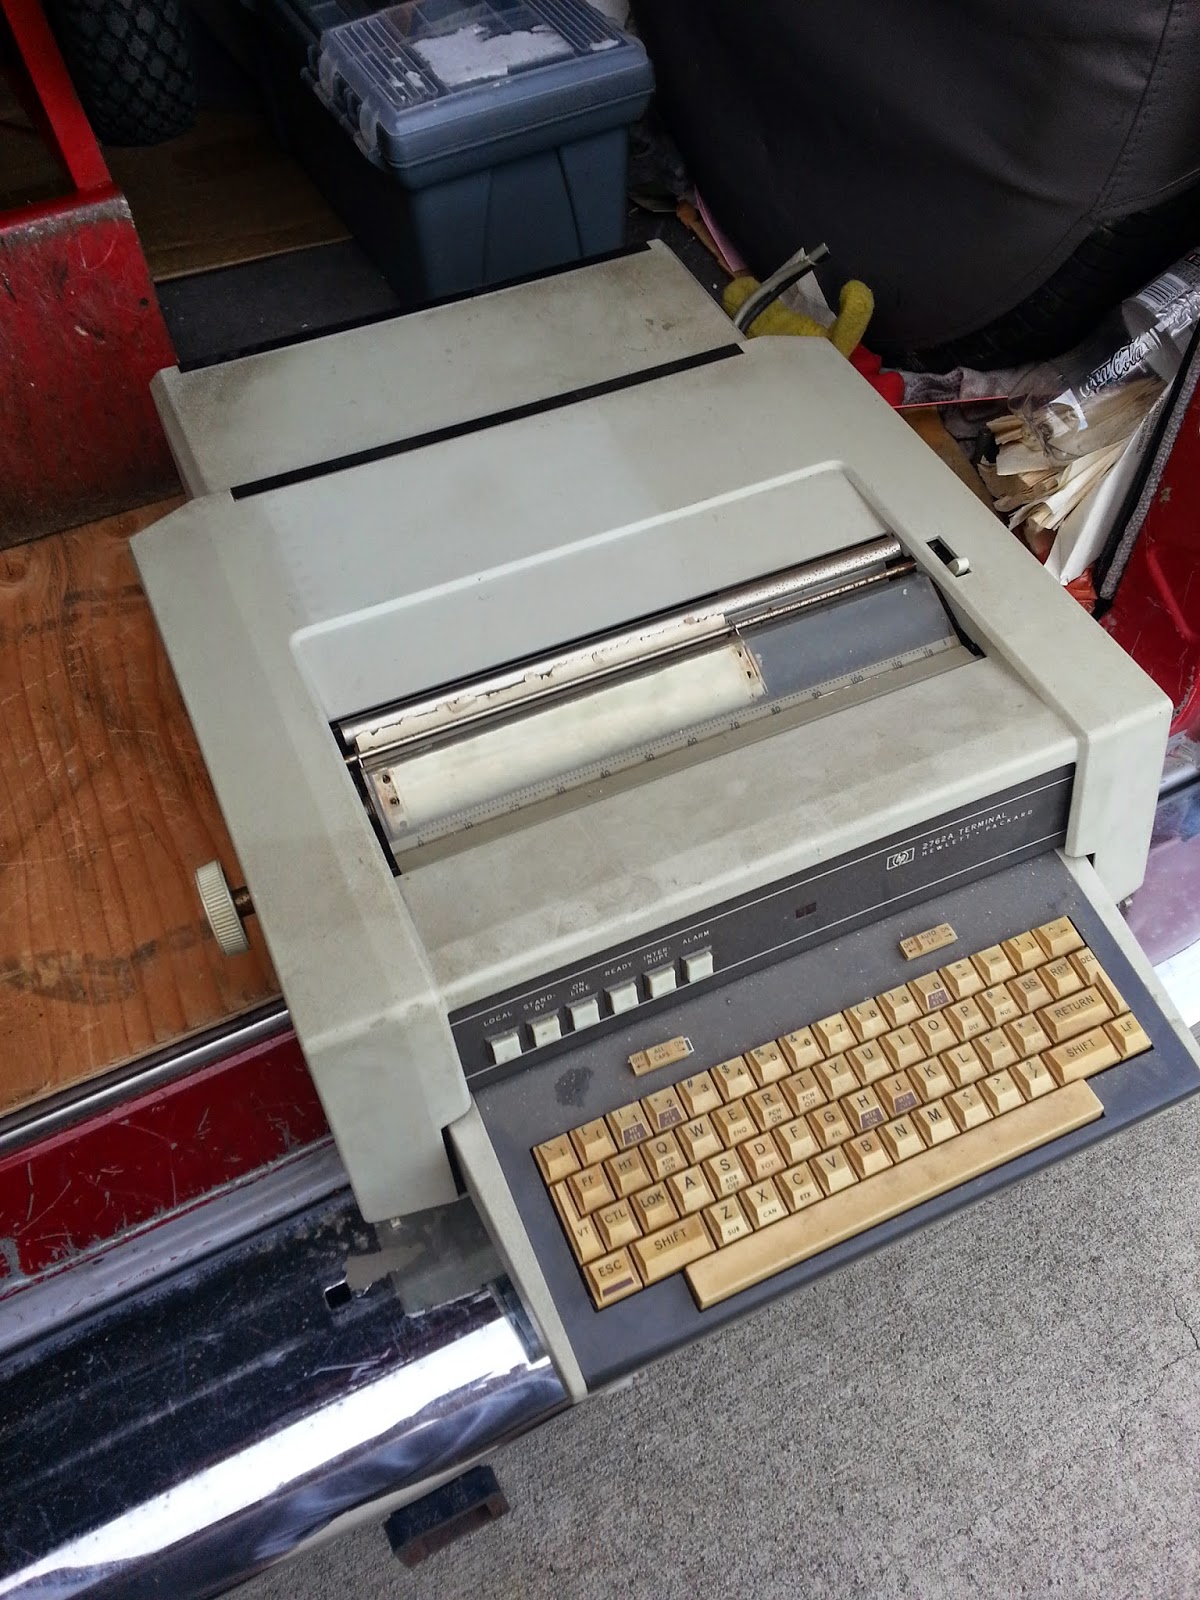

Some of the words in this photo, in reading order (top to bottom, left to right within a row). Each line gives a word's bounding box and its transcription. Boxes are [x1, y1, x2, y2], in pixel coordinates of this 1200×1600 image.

[464, 821, 474, 830] 10
[600, 769, 611, 778] 40
[644, 753, 655, 762] 50
[687, 737, 698, 746] 60
[729, 721, 741, 730] 70
[771, 706, 781, 715] 80
[850, 675, 864, 684] 100
[891, 660, 903, 669] 110
[921, 834, 970, 857] HEWLETT
[985, 809, 1034, 831] PACKARD
[922, 833, 954, 850] 2762A
[958, 812, 1007, 834] TERMINAL
[682, 930, 710, 945] ALARM
[920, 930, 937, 939] AUTO
[647, 953, 669, 965] RUPT
[1080, 954, 1095, 964] DEL
[605, 961, 632, 977] READY
[1050, 962, 1071, 977] RPT
[572, 981, 585, 990] ON
[1021, 978, 1037, 990] BS
[570, 985, 591, 997] LINE
[901, 995, 909, 1004] 9
[534, 1003, 546, 1013] BY
[960, 1005, 969, 1017] P
[1054, 995, 1095, 1018] RETURN
[483, 1011, 512, 1027] LOCAL
[868, 1009, 877, 1018] 8
[928, 1020, 939, 1031] O
[1120, 1021, 1133, 1032] LF
[804, 1038, 811, 1047] 6
[1066, 1038, 1096, 1057] SHIFT
[769, 1053, 778, 1061] 5
[861, 1048, 874, 1060] U
[957, 1052, 970, 1063] L
[737, 1068, 744, 1076] 4
[829, 1062, 839, 1074] Y
[923, 1064, 937, 1077] K
[701, 1084, 709, 1093] 3
[795, 1077, 805, 1089] T
[894, 1080, 902, 1092] J
[761, 1093, 774, 1105] R
[802, 1092, 815, 1101] PCH
[856, 1095, 870, 1108] H
[727, 1108, 738, 1121] E
[771, 1115, 782, 1123] ON
[823, 1111, 836, 1122] G
[927, 1107, 942, 1122] M
[689, 1123, 704, 1138] W
[733, 1126, 747, 1136] ENQ
[790, 1126, 798, 1139] F
[894, 1124, 908, 1137] N
[656, 1141, 667, 1154] Q
[754, 1143, 766, 1155] D
[860, 1140, 873, 1152] B
[720, 1158, 731, 1171] S
[825, 1155, 836, 1169] V
[581, 1175, 594, 1187] FF
[685, 1176, 696, 1189] A
[792, 1173, 804, 1185] C
[640, 1191, 664, 1208] LOK
[756, 1189, 769, 1203] X
[604, 1209, 627, 1224] CTL
[720, 1205, 733, 1220] Z
[763, 1208, 777, 1218] CAN
[577, 1226, 589, 1237] VT
[727, 1225, 740, 1236] SUB
[654, 1228, 687, 1251] SHIFT
[598, 1260, 622, 1278] ESC
